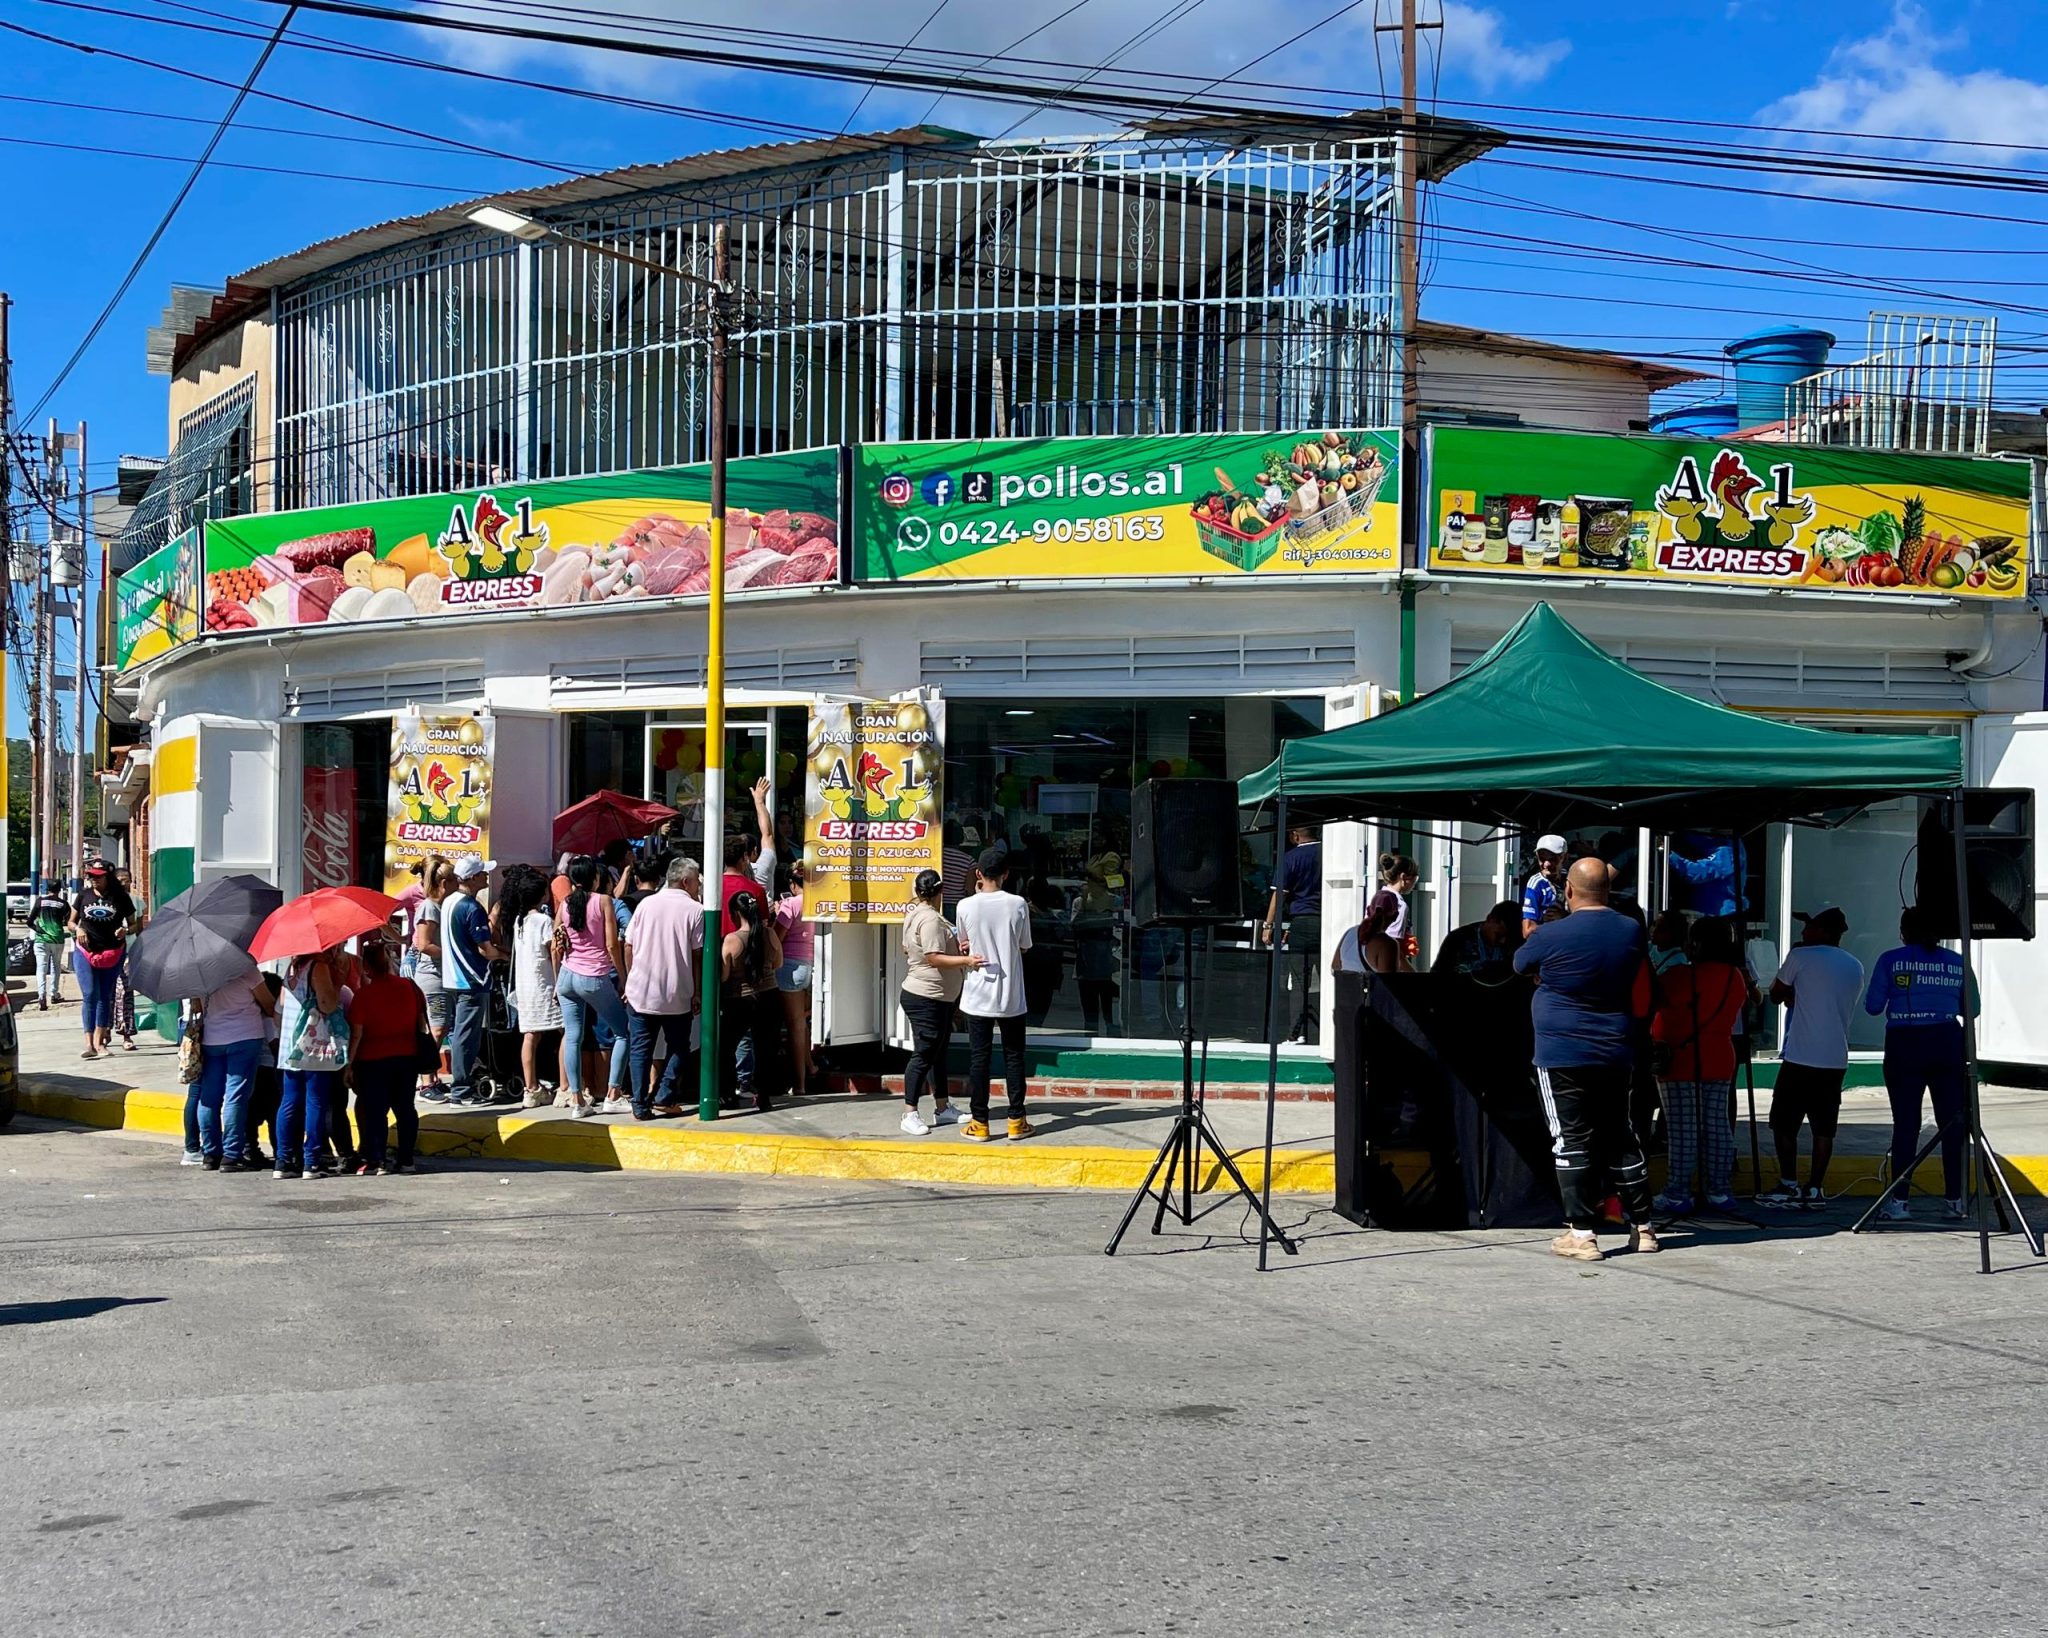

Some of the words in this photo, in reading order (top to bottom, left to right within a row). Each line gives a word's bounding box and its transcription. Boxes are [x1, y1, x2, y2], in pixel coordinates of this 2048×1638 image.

[1668, 457, 1707, 504] A
[1772, 464, 1798, 508] 1
[446, 506, 472, 544] A
[516, 498, 542, 538] 1
[938, 514, 1164, 547] 0424-9058163
[1283, 549, 1301, 560] Rif
[1302, 548, 1392, 561] J-30401694-8
[1672, 546, 1795, 574] EXPRESS
[449, 577, 536, 603] EXPRESS
[855, 715, 898, 728] GRAN
[427, 729, 460, 741] GRAN
[818, 730, 935, 744] INAUGURACIÓN
[399, 742, 487, 756] INAUGURACIÓN
[404, 767, 424, 796] A
[827, 757, 854, 790] A
[403, 824, 472, 843] EXPRESS
[828, 821, 919, 840] EXPRESS
[303, 804, 350, 888] Cola
[397, 845, 423, 856] CAÑA
[425, 848, 438, 857] DE
[818, 845, 854, 858] CAÑA
[857, 848, 875, 858] DE
[878, 848, 931, 858] AZUCAR
[816, 865, 852, 873] SABADO
[880, 866, 932, 874] NOVIEMB
[816, 902, 837, 913] ¡TE
[840, 902, 917, 914] ESPERAMO
[1905, 961, 1945, 972] Internet
